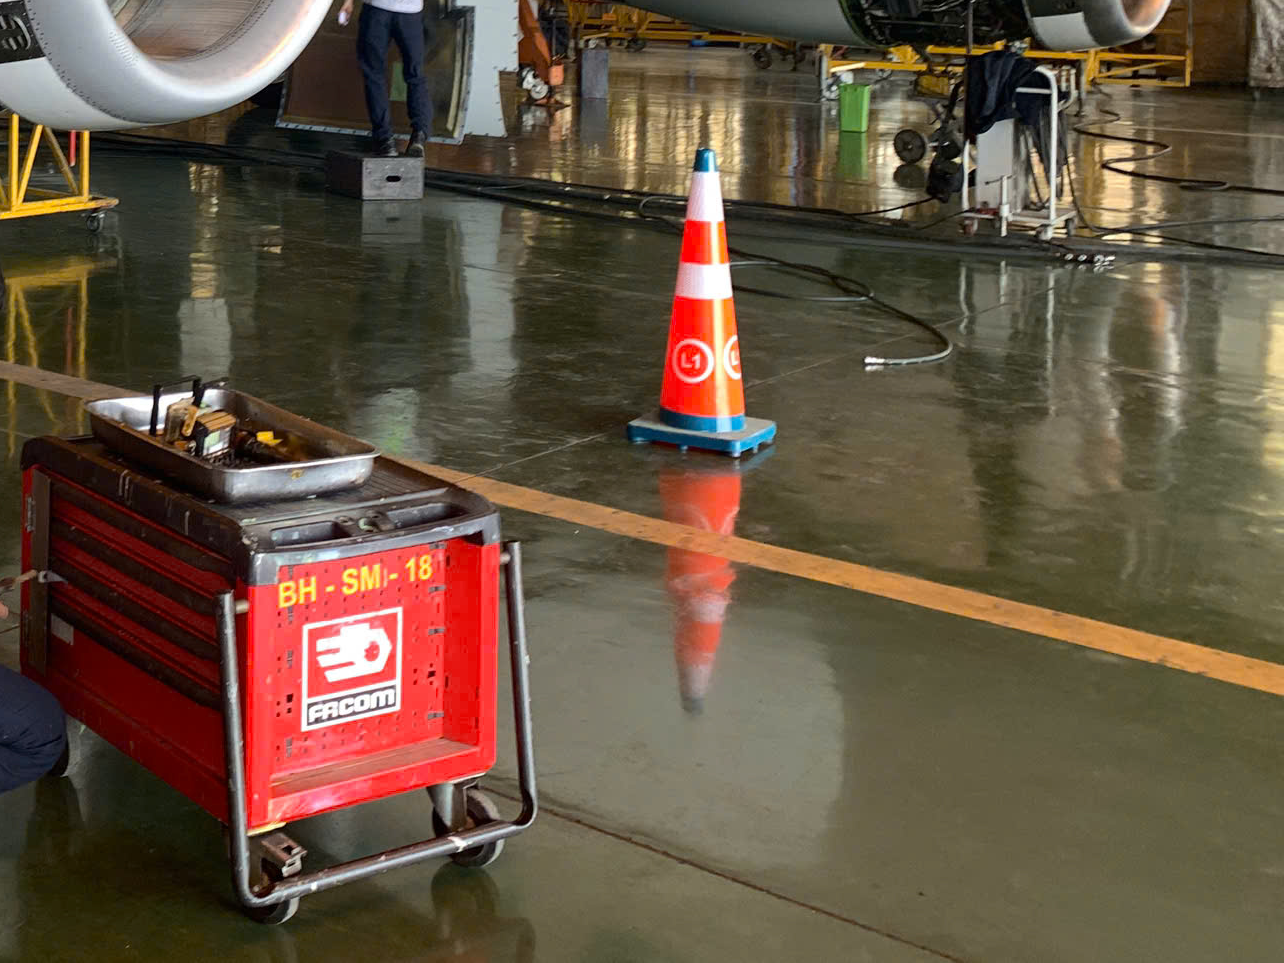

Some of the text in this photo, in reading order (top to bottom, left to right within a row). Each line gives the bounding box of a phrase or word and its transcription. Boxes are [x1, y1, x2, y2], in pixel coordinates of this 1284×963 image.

[680, 352, 701, 370] L1
[278, 575, 317, 609] BH
[405, 554, 432, 581] 18
[308, 688, 396, 724] FACOM
